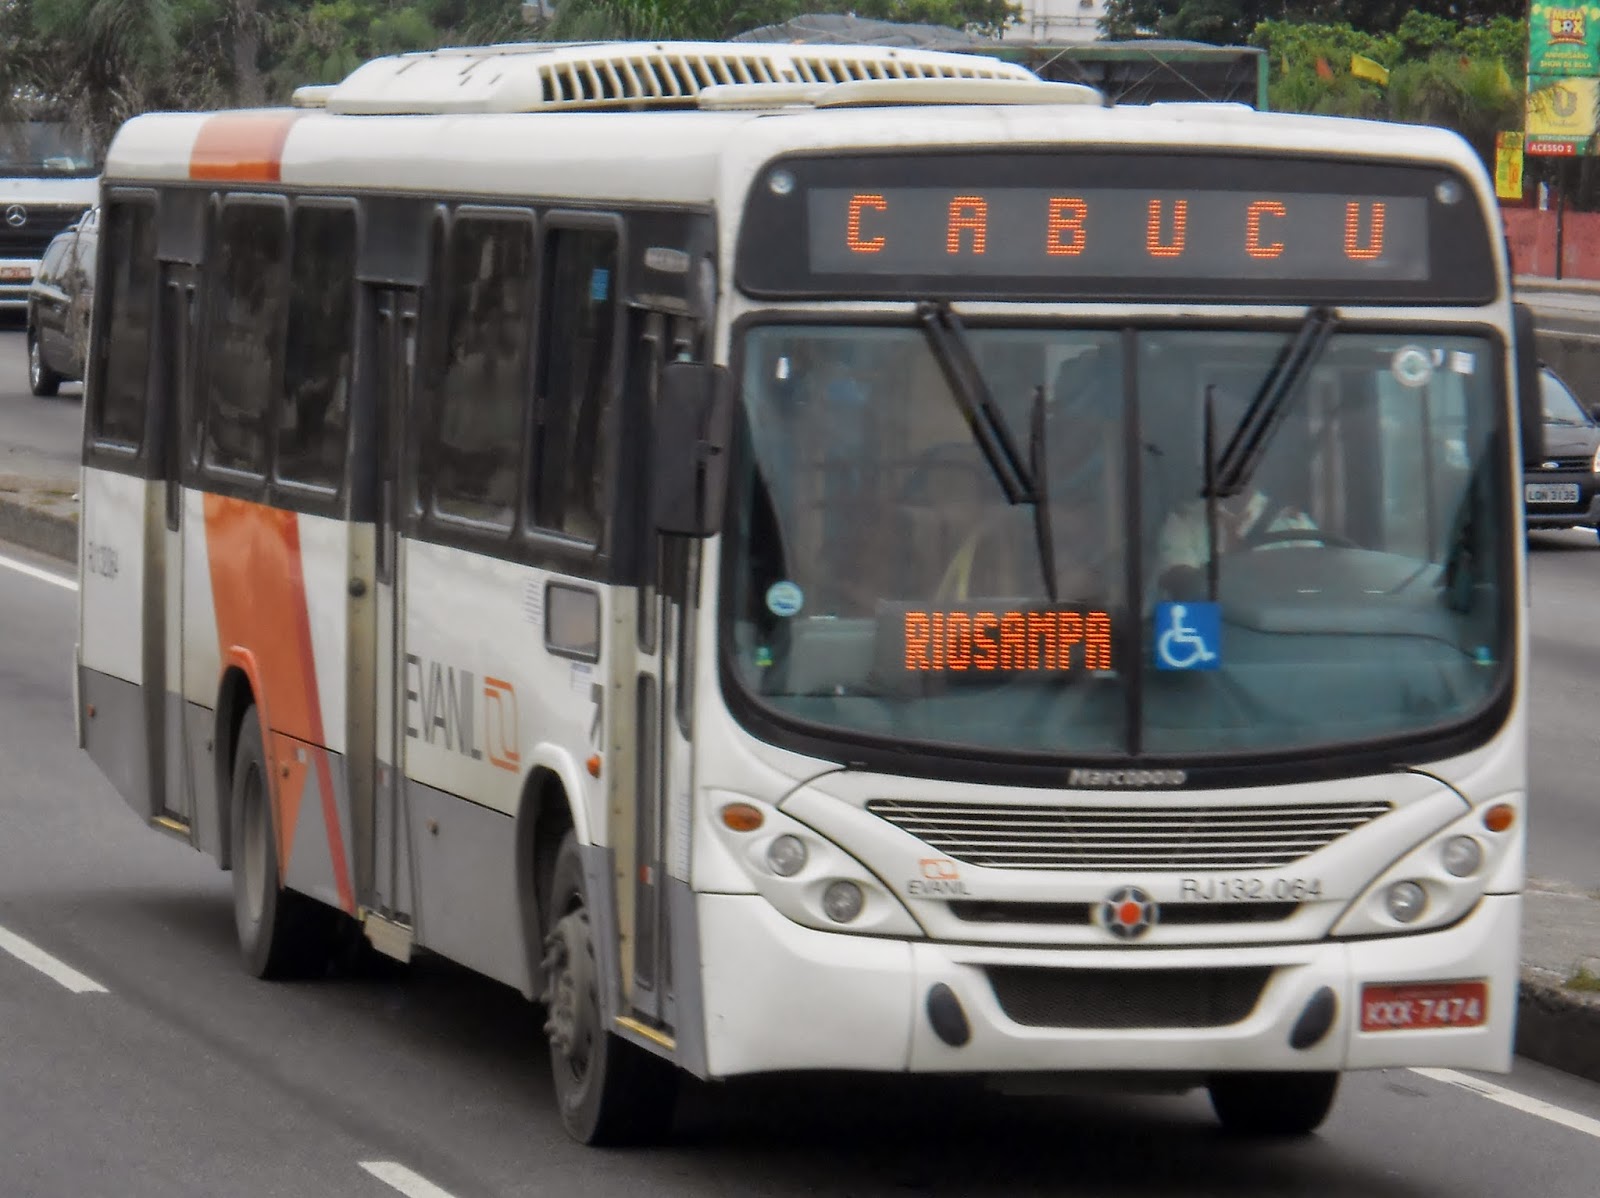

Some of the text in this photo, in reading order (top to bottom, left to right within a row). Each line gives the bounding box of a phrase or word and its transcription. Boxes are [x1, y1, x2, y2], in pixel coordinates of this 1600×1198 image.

[1531, 144, 1565, 152] ACESSO
[905, 611, 1111, 671] RIOSAMPA
[907, 880, 971, 896] EVANIL
[1180, 878, 1322, 899] RJ132.064
